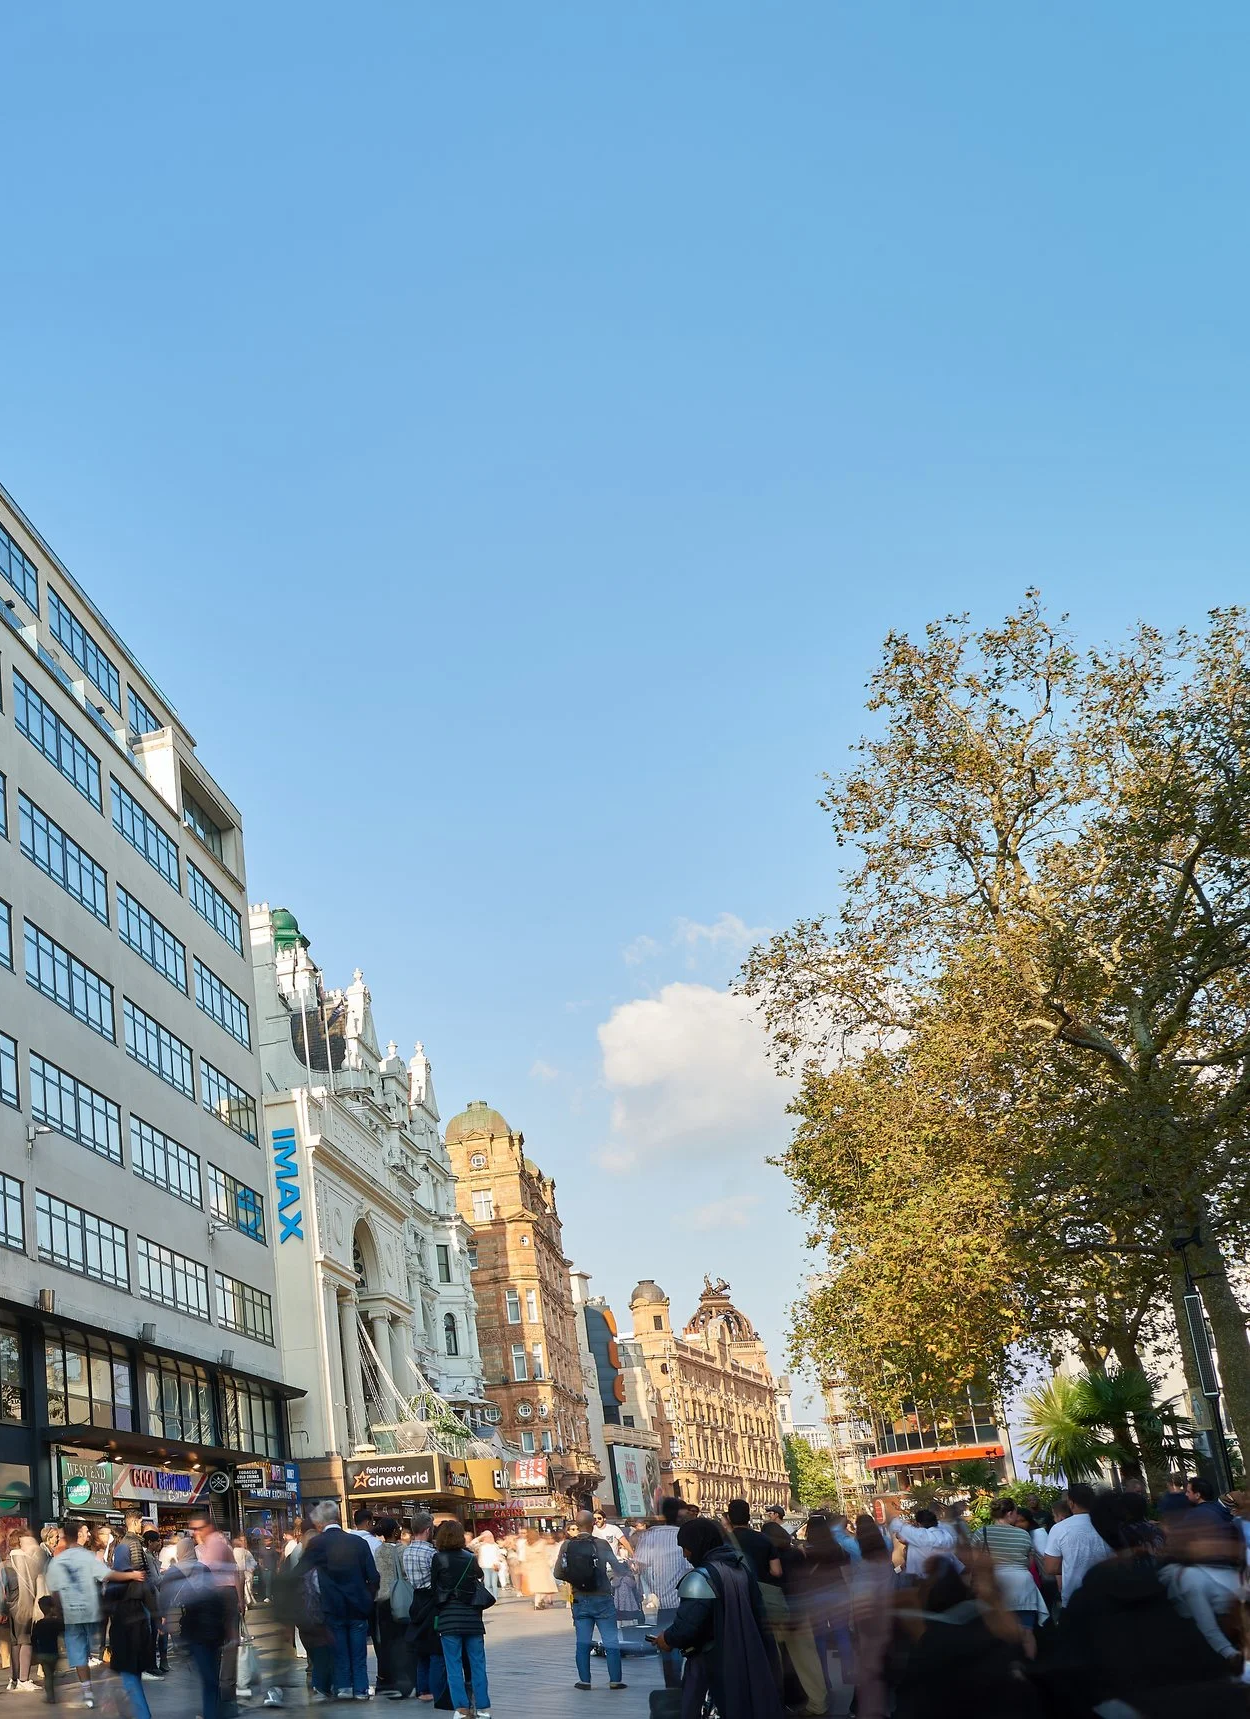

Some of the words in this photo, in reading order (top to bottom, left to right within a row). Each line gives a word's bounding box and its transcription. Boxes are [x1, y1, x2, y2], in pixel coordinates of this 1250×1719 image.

[272, 1128, 303, 1244] IMAX
[67, 1463, 88, 1477] WEST
[90, 1465, 106, 1480] END
[368, 1471, 429, 1487] cineworld
[90, 1482, 111, 1496] DRINK
[257, 1489, 271, 1497] MONEY
[272, 1490, 292, 1499] EXCHANGE
[494, 1508, 528, 1517] CASINO
